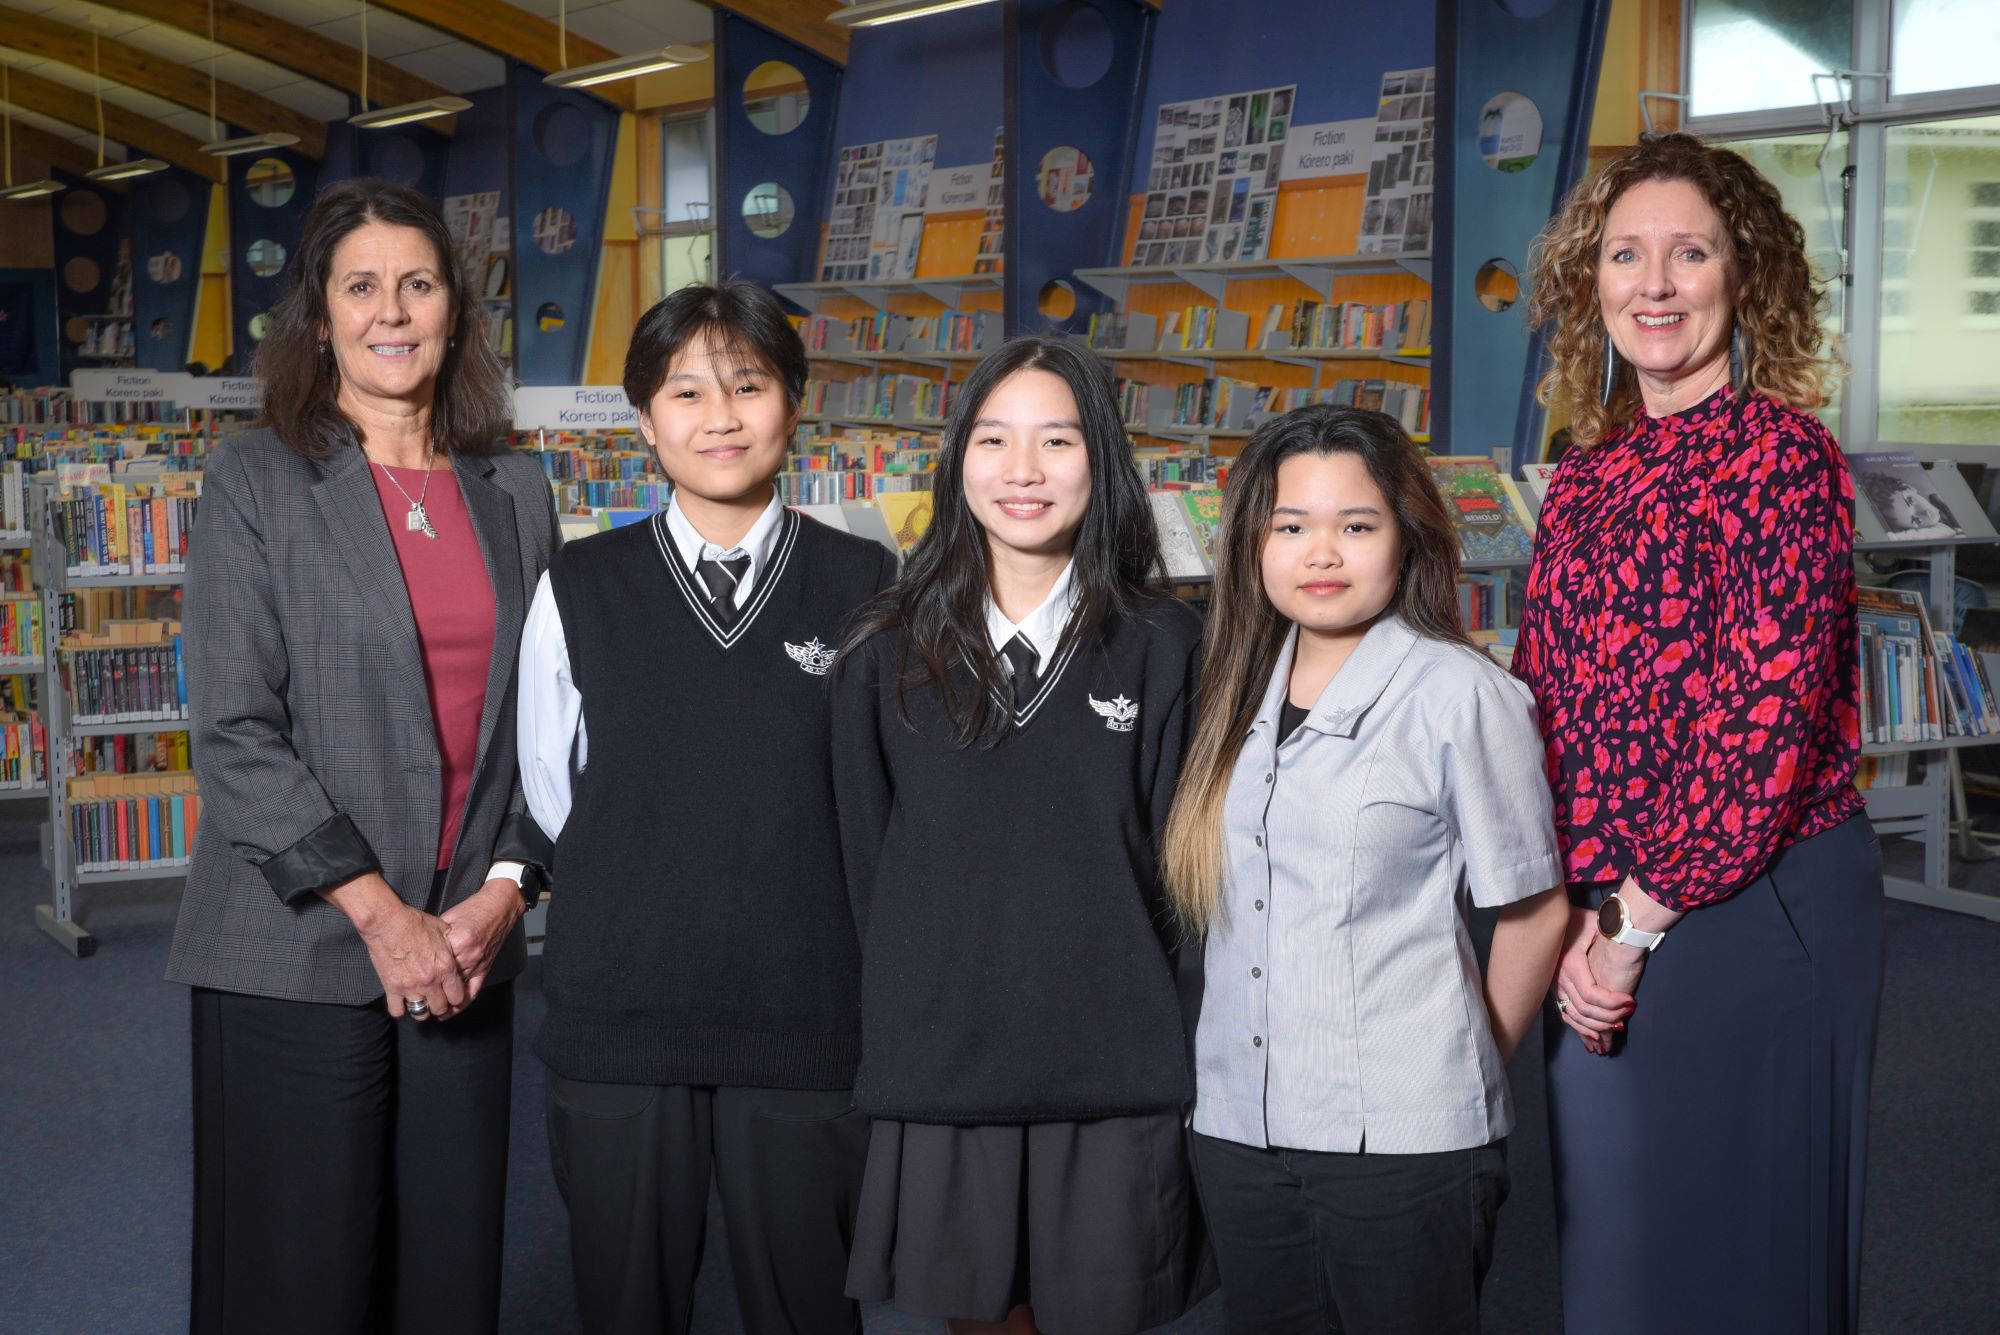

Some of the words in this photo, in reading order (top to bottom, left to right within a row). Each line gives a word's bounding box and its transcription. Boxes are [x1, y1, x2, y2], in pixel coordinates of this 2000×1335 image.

[1312, 130, 1345, 146] Fiction
[1332, 149, 1354, 170] paki
[117, 375, 151, 385] Fiction
[143, 388, 164, 399] paki
[575, 390, 623, 403] Fiction
[1464, 513, 1502, 522] BEHOLD!
